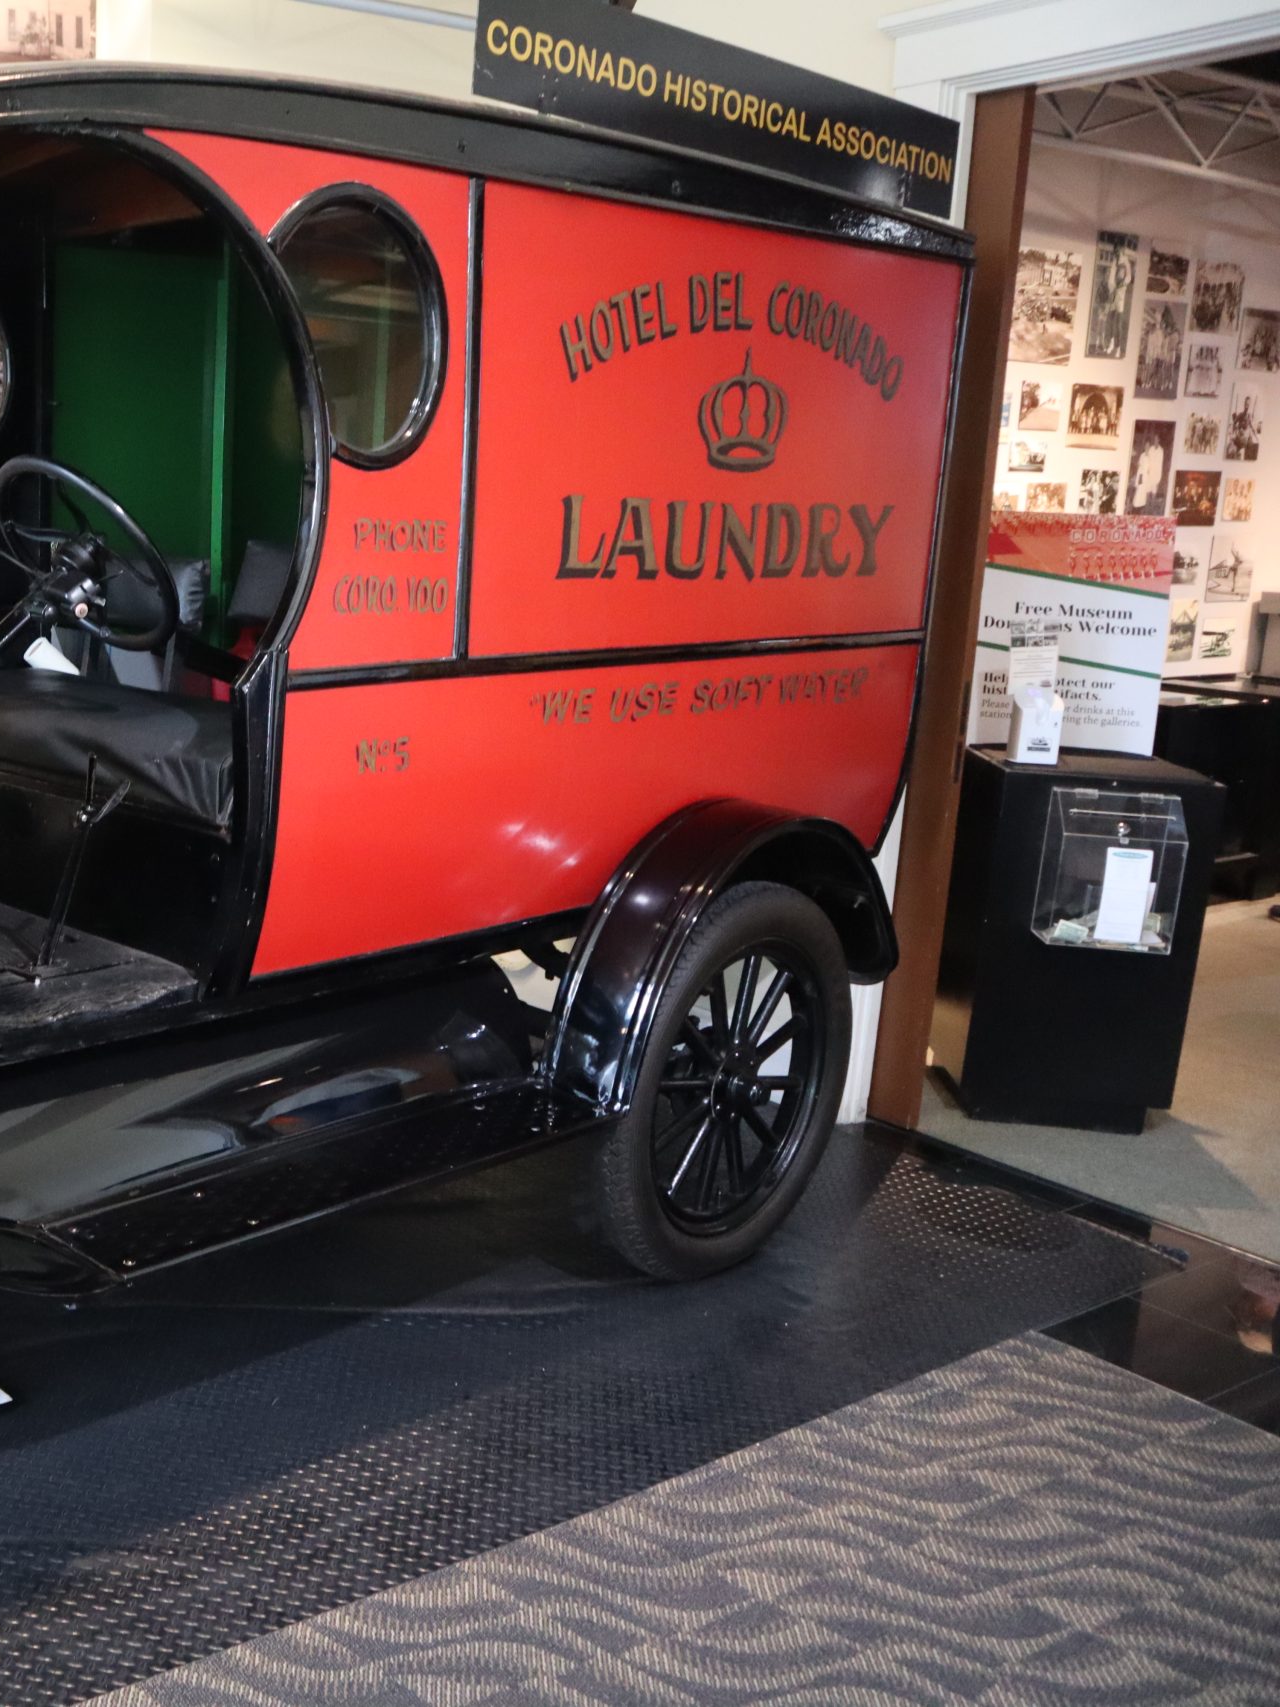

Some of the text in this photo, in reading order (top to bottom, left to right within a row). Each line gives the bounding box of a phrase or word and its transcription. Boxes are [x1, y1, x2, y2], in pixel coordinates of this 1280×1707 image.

[487, 19, 952, 184] CORONADO HISTORICAL ASSOCIATION
[560, 271, 904, 402] HOTEL DEL CORONADO
[354, 517, 448, 552] PHONE
[555, 495, 895, 582] LAUNDRY
[407, 576, 449, 613] 100
[1015, 601, 1133, 620] Free Museum
[1079, 620, 1158, 637] Welcome
[609, 681, 680, 722] USE
[690, 674, 773, 714] SOFT
[1091, 680, 1115, 690] our
[981, 698, 1010, 709] Please
[1073, 704, 1103, 715] drinks
[1117, 706, 1135, 717] this
[1083, 715, 1099, 726] the
